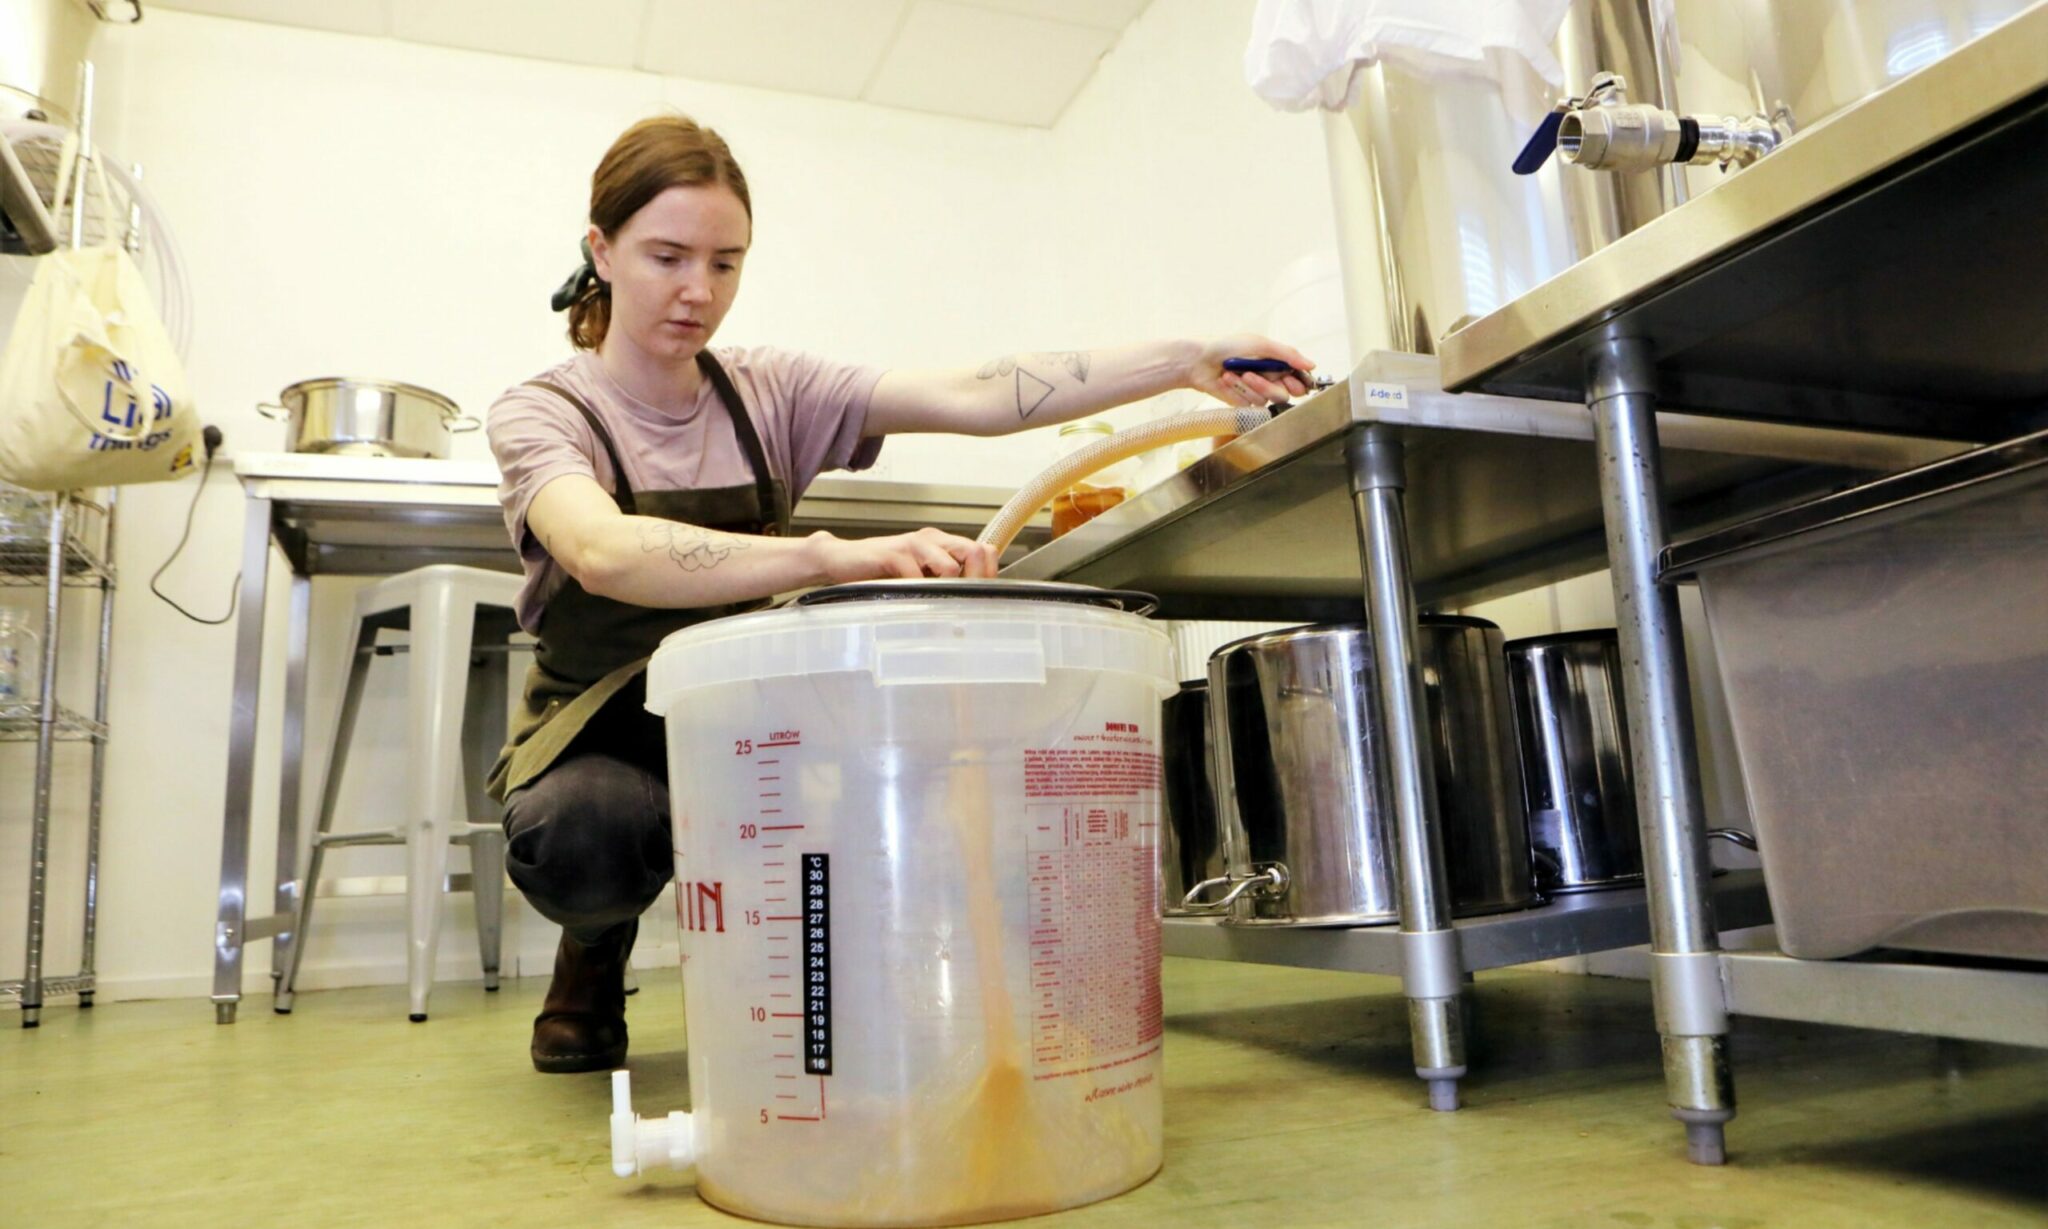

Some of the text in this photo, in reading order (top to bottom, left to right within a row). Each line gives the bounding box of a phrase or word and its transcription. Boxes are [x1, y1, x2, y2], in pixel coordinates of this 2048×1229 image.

[769, 729, 800, 741] LITRÓW
[735, 740, 752, 755] 25
[740, 824, 757, 839] 20
[809, 870, 823, 881] 30
[809, 885, 824, 896] 29
[809, 899, 824, 910] 28
[745, 910, 761, 925] 15
[810, 913, 824, 924] 27
[810, 928, 824, 939] 26
[810, 943, 824, 954] 25
[810, 957, 824, 968] 24
[811, 971, 825, 982] 23
[811, 986, 825, 997] 22
[811, 1000, 824, 1011] 21
[750, 1006, 766, 1022] 10
[812, 1015, 825, 1025] 19
[812, 1029, 825, 1040] 18
[812, 1044, 825, 1054] 17
[812, 1058, 826, 1069] 16
[760, 1109, 769, 1124] 5
